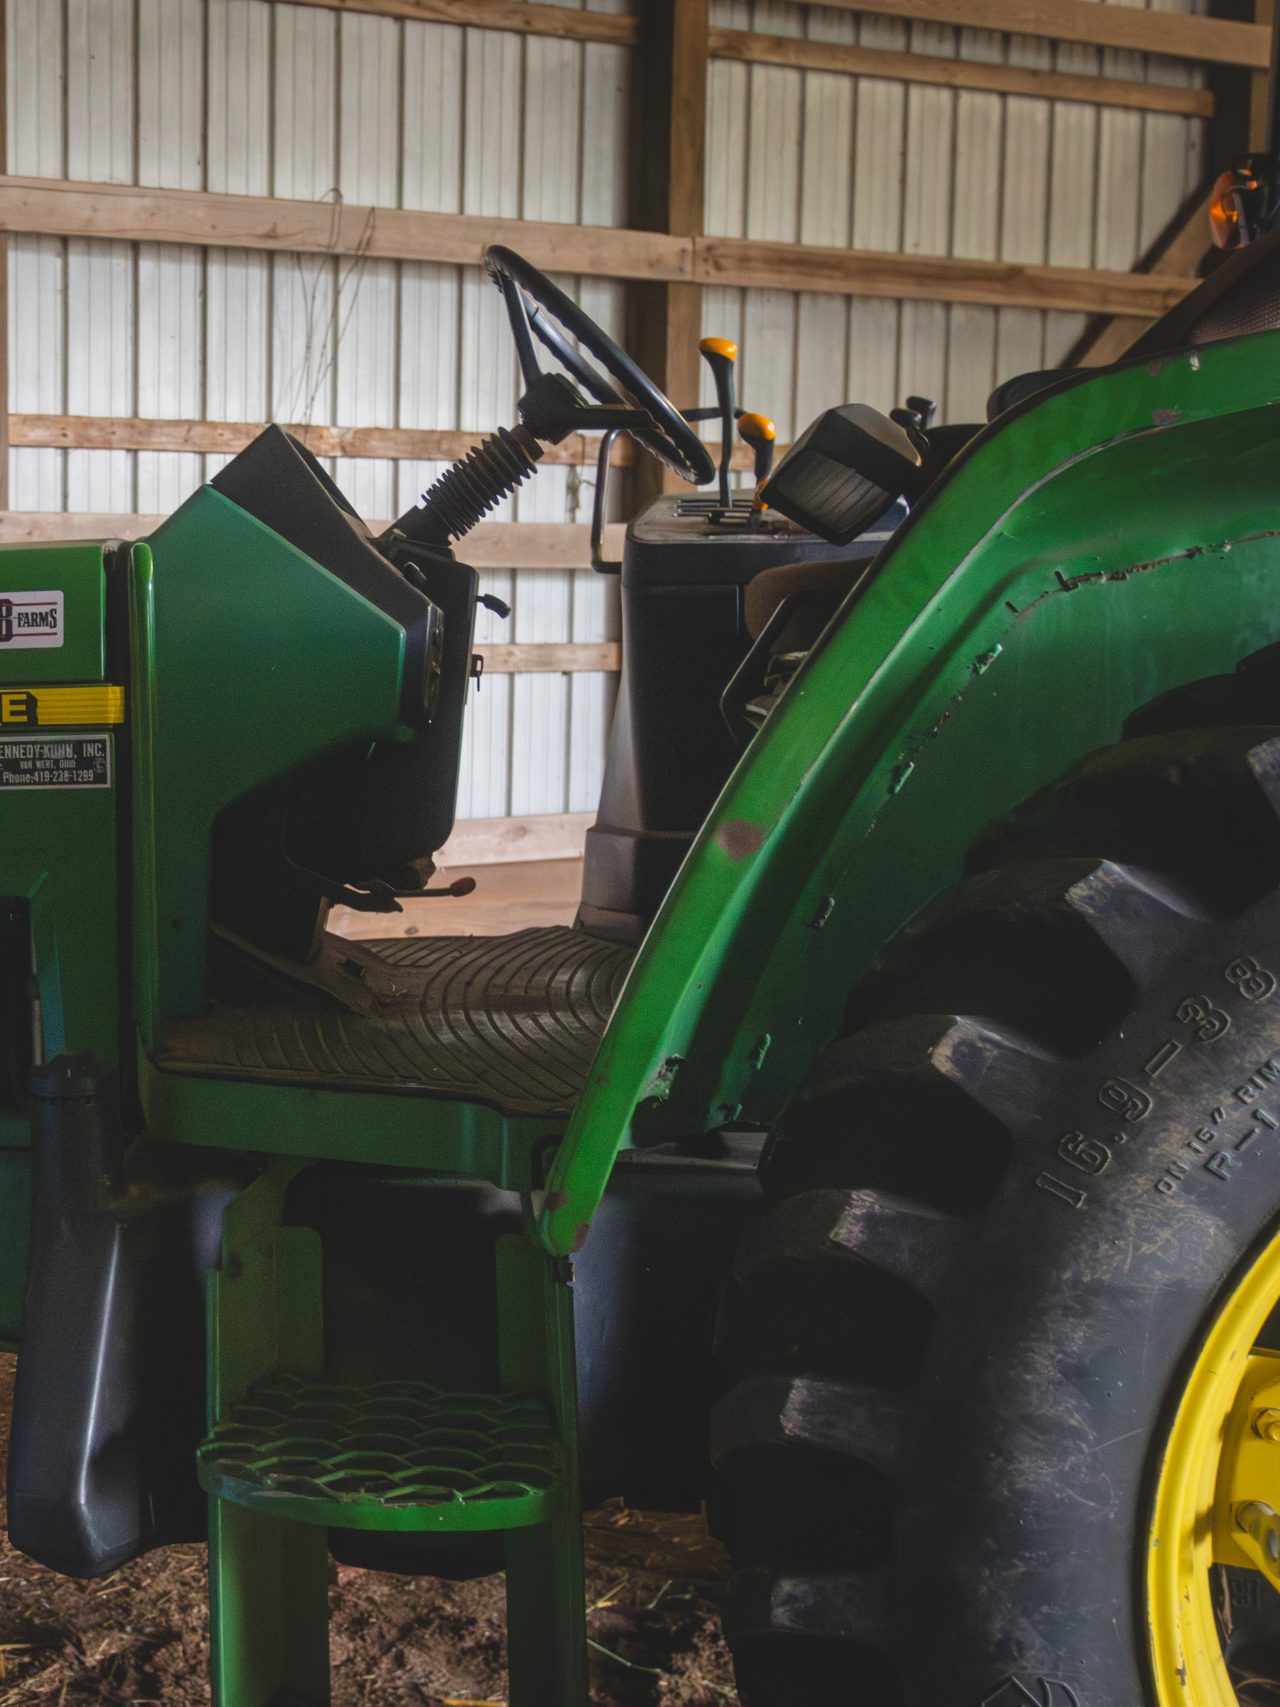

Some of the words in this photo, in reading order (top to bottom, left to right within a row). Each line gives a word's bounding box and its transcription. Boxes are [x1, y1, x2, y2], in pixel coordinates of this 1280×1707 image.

[17, 608, 58, 629] FARMS
[82, 742, 105, 758] INC.
[1156, 1160, 1190, 1196] ON
